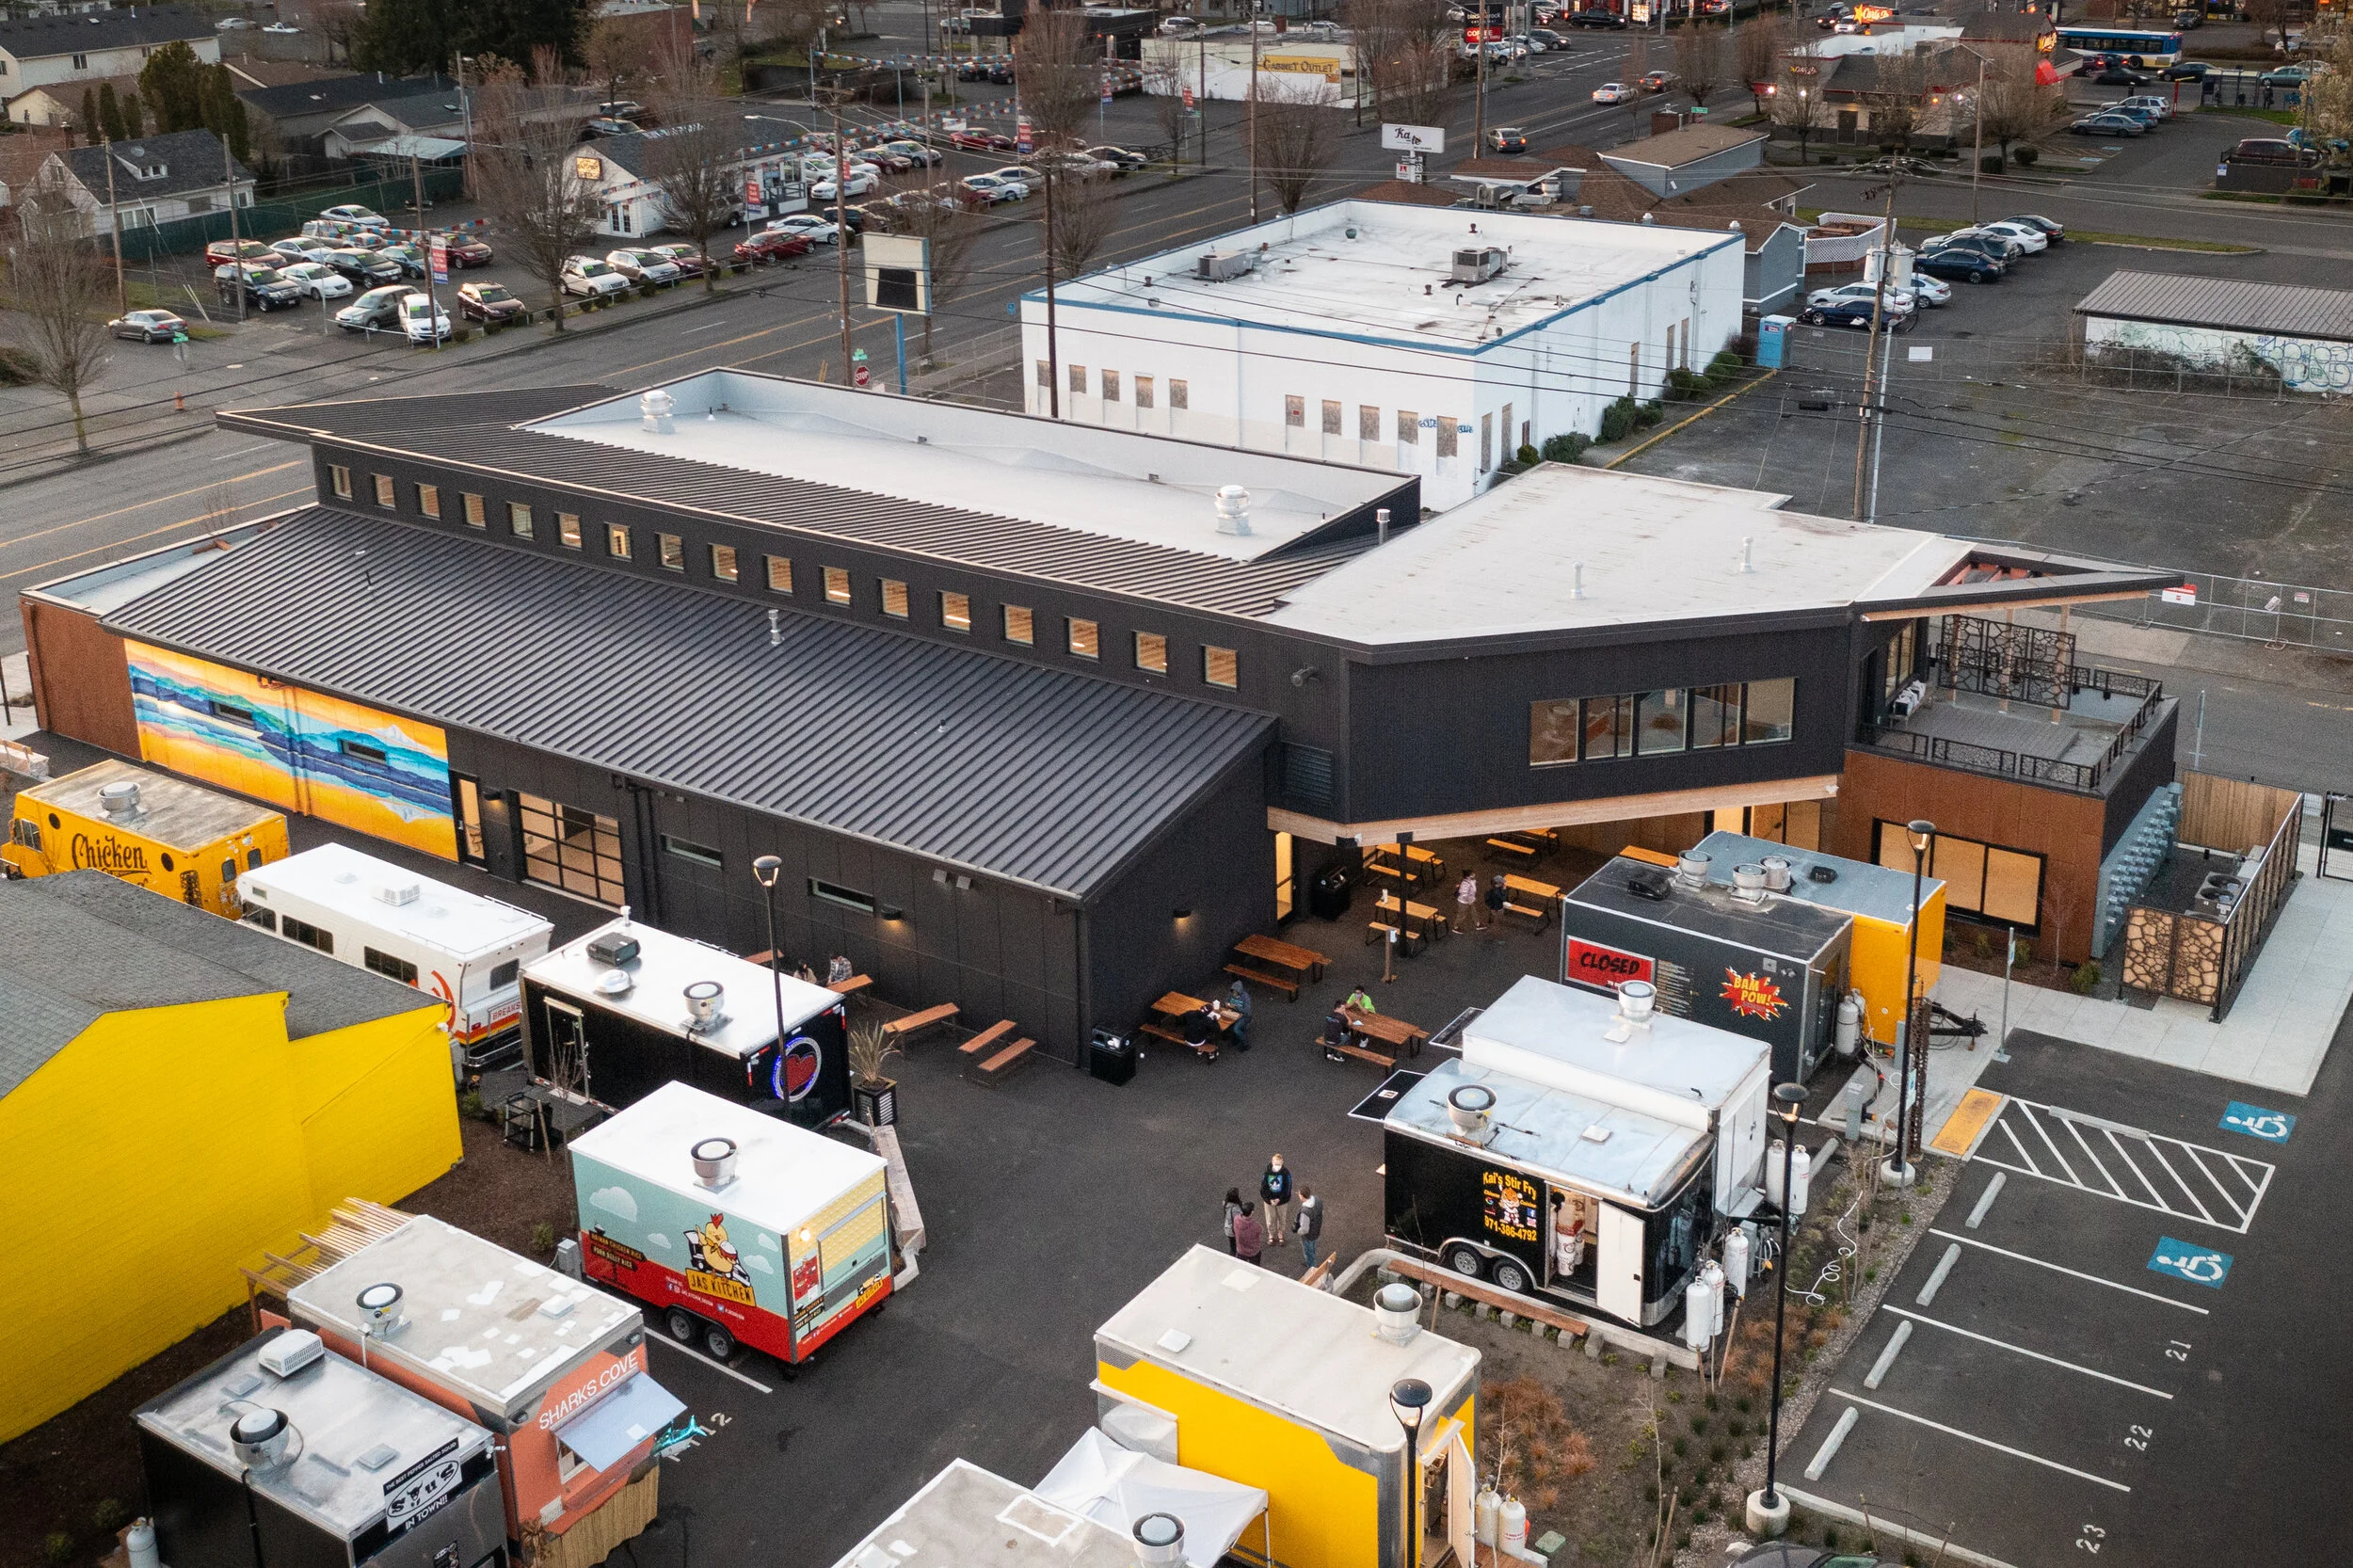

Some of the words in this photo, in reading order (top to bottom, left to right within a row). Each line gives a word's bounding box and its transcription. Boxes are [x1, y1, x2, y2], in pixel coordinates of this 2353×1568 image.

[1263, 59, 1298, 72] CABINET
[1301, 60, 1334, 72] OUTLET
[856, 371, 869, 381] STOP
[72, 833, 149, 870] Chicken
[1580, 952, 1641, 975] CLOSED
[1733, 977, 1759, 992] BAM
[1740, 989, 1772, 1006] POW!
[1482, 1171, 1503, 1185] Kai's
[1504, 1175, 1522, 1190] Stir
[1522, 1180, 1537, 1201] Fry
[1484, 1214, 1537, 1241] 971-386-4792
[691, 1272, 709, 1290] JAS
[711, 1279, 751, 1302] KITCHEN
[2165, 1339, 2192, 1361] 21
[538, 1379, 598, 1430] SHARKS
[600, 1350, 638, 1387] COVE
[2123, 1424, 2153, 1451] 22
[386, 1481, 395, 1491] THE
[395, 1473, 408, 1484] BEST
[407, 1463, 424, 1478] PEPPER
[424, 1452, 441, 1465] SALTED
[440, 1442, 456, 1454] SQUID
[405, 1516, 415, 1530] IN
[2075, 1523, 2106, 1554] 23
